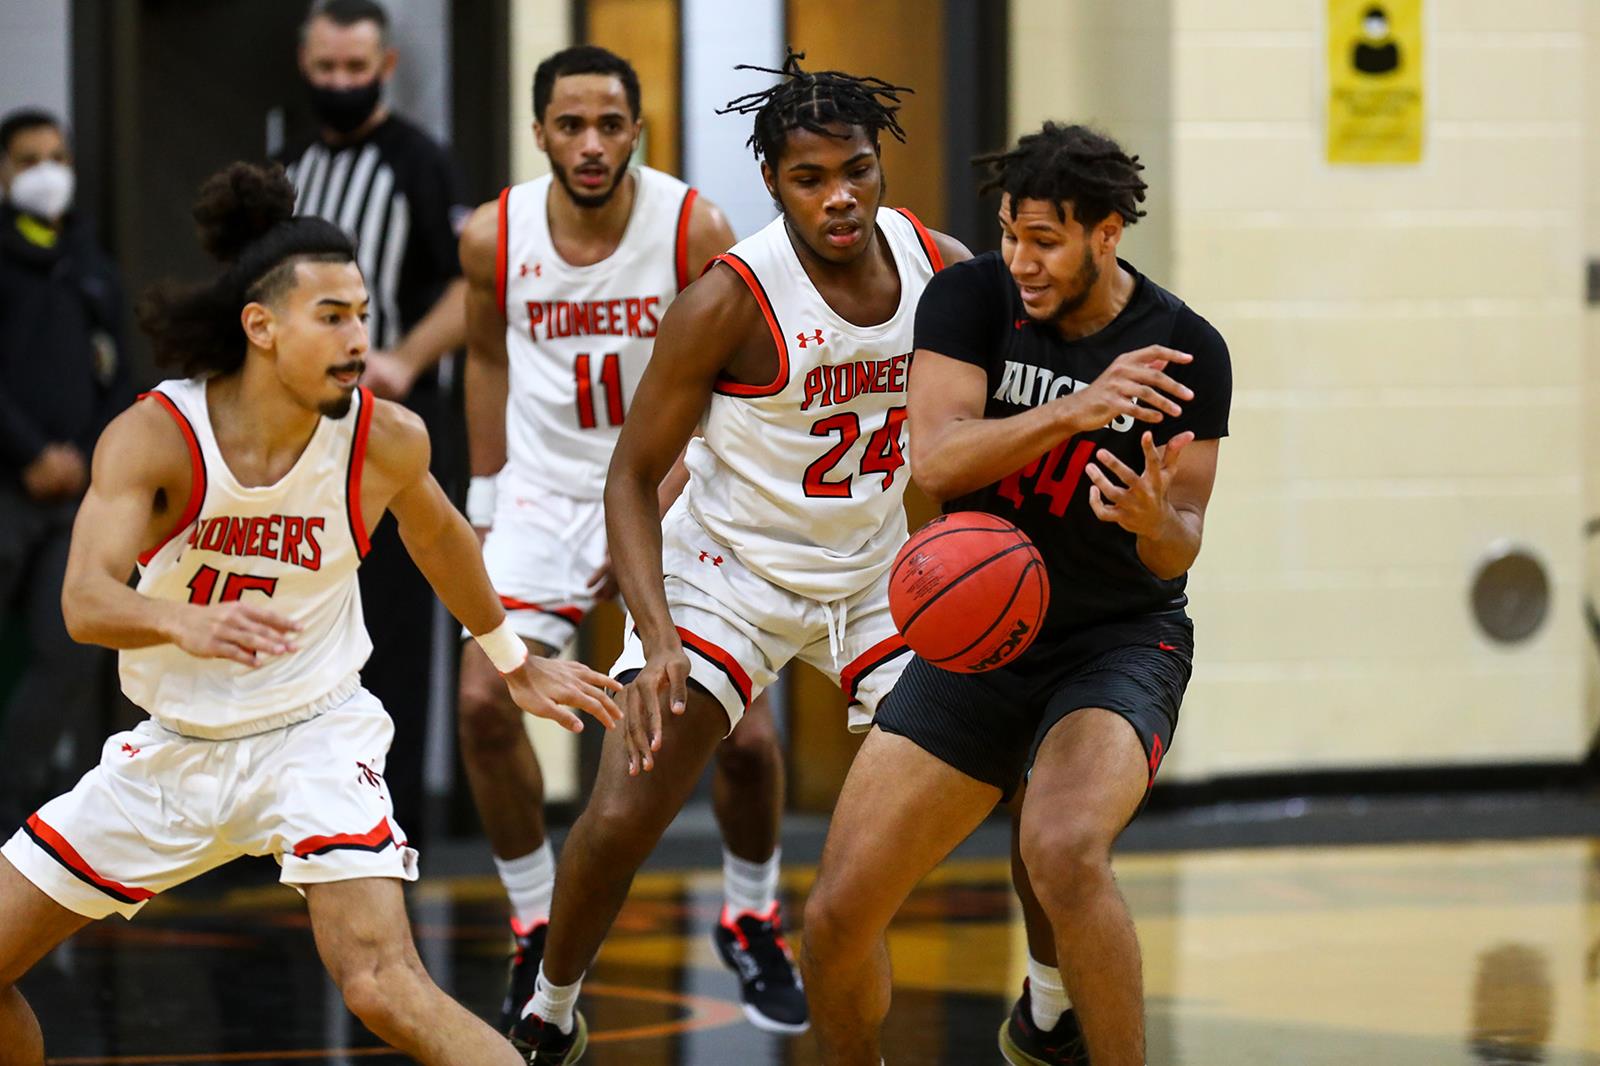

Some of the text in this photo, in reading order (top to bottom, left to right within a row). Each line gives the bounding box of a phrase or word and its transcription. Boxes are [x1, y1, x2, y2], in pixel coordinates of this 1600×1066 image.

[526, 296, 660, 342] PIONEERS
[573, 353, 626, 429] 11
[800, 352, 914, 411] PIONEE
[802, 406, 909, 498] 24
[966, 618, 1030, 671] NCAA
